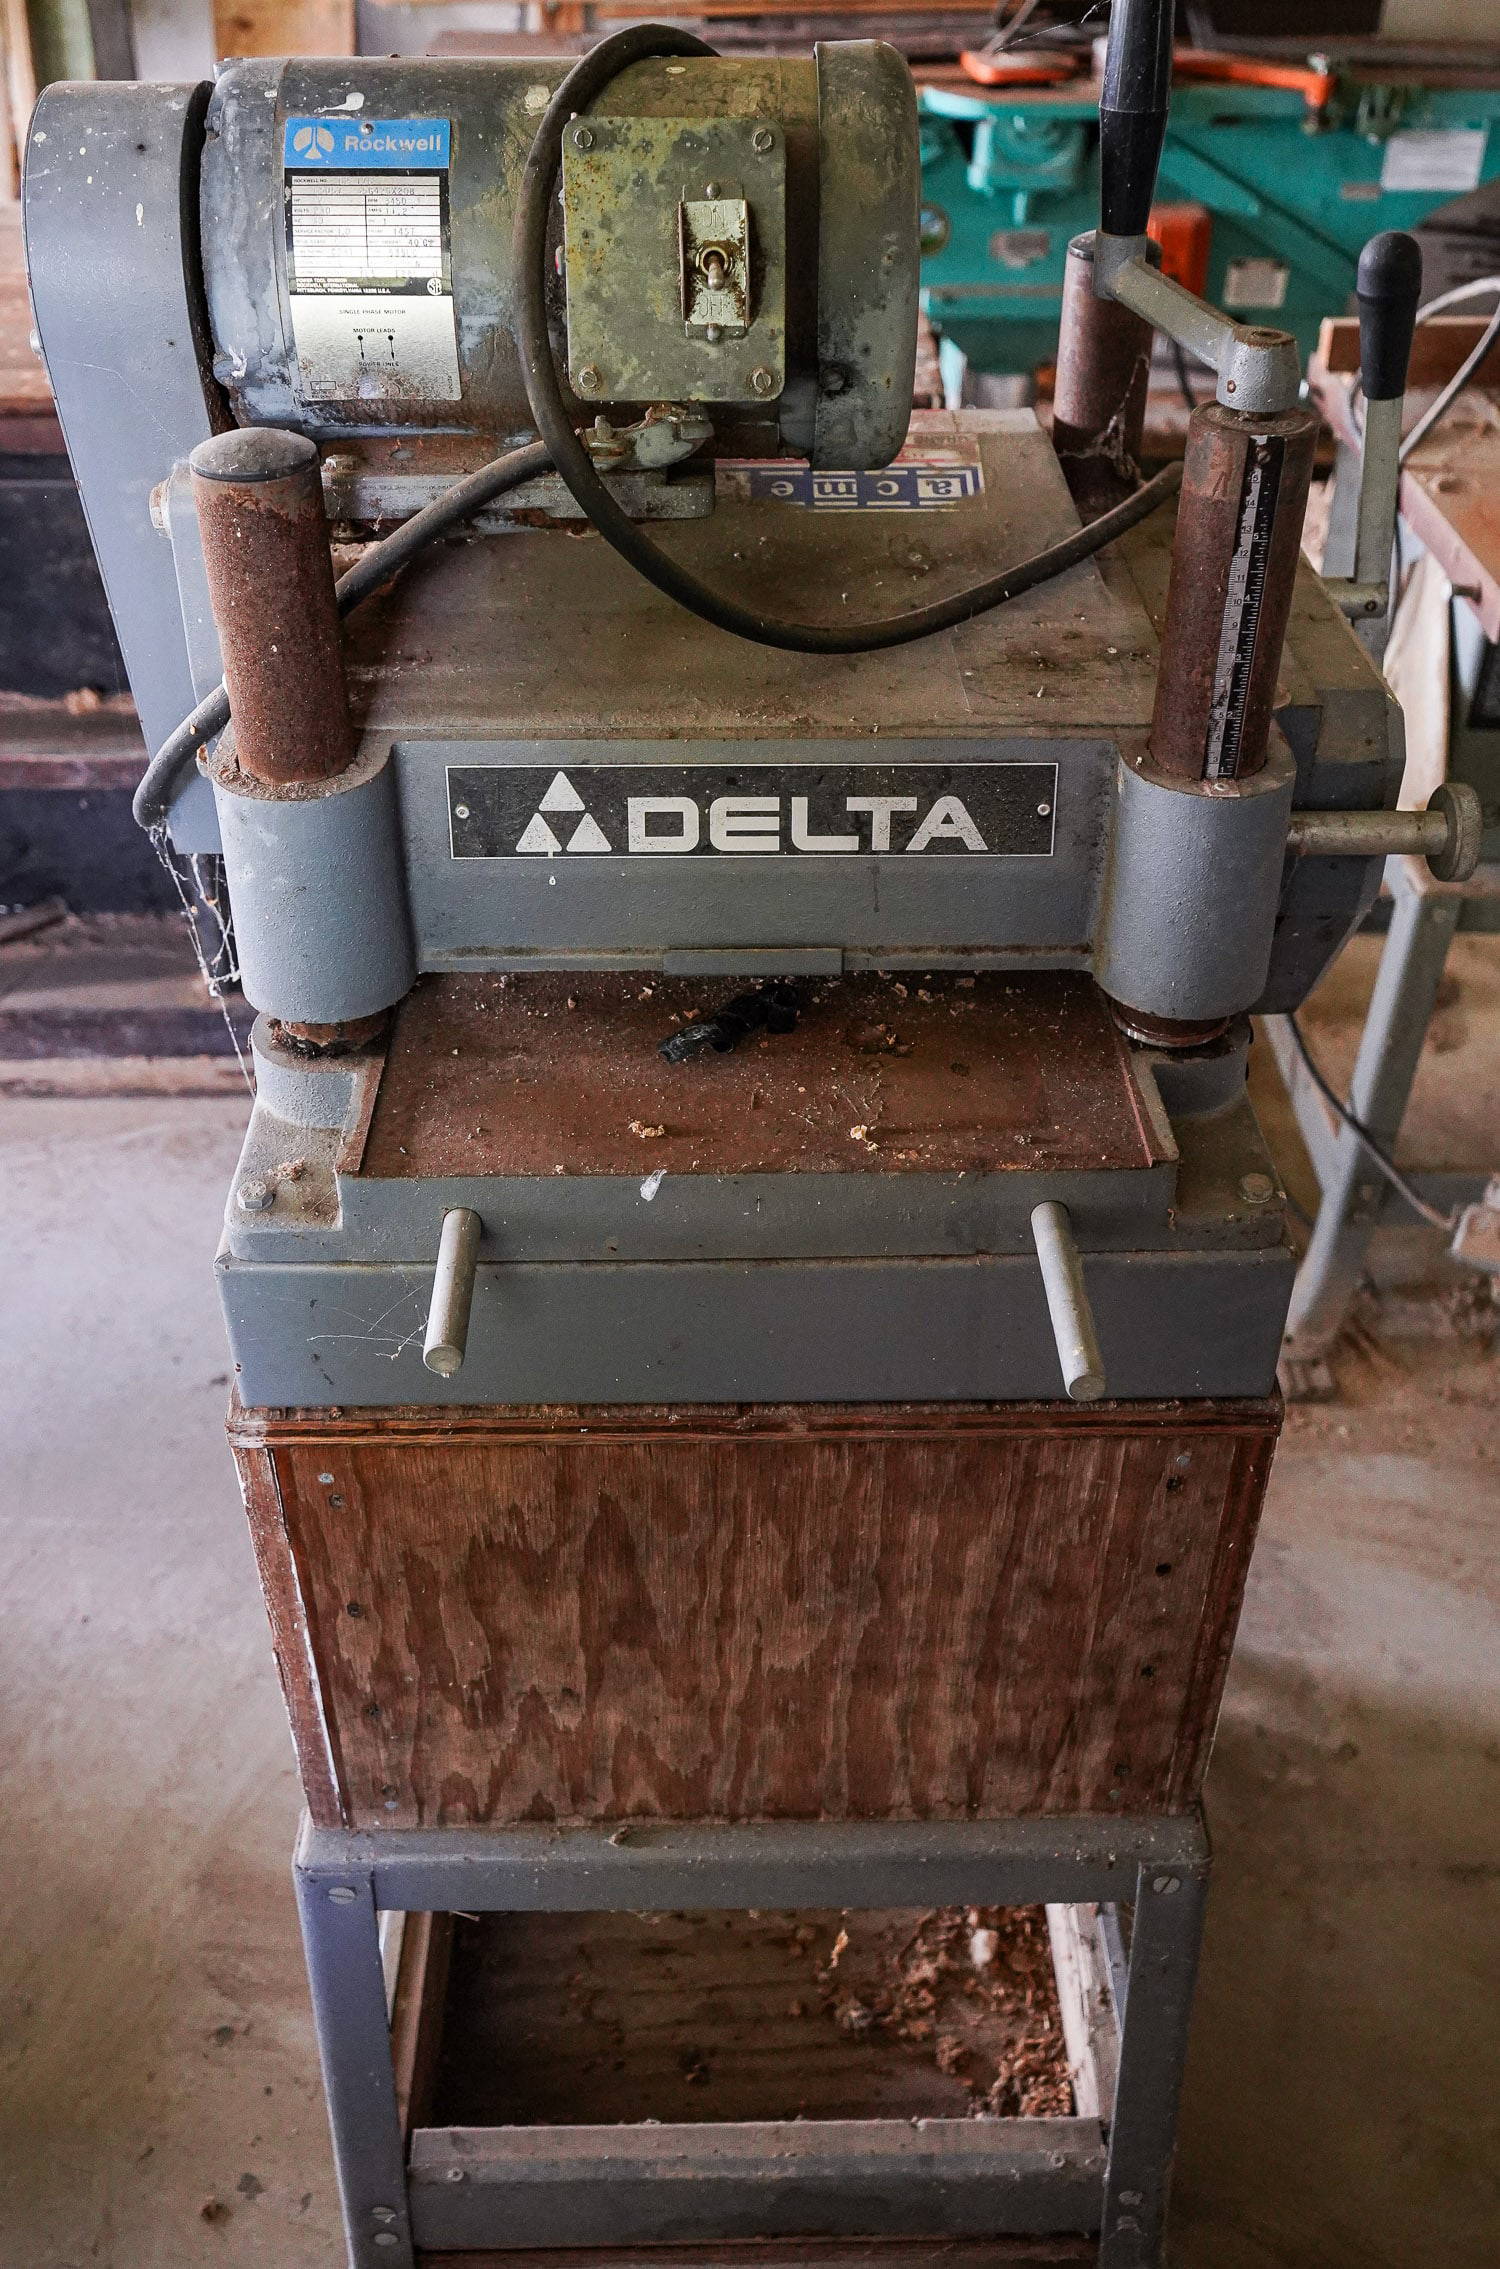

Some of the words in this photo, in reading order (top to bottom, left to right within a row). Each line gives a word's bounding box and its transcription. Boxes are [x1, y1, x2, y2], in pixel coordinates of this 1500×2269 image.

[345, 135, 441, 151] Rockwell
[702, 204, 726, 228] ON
[771, 478, 953, 497] acme
[1234, 598, 1242, 606] 10
[627, 795, 989, 852] DELTA
